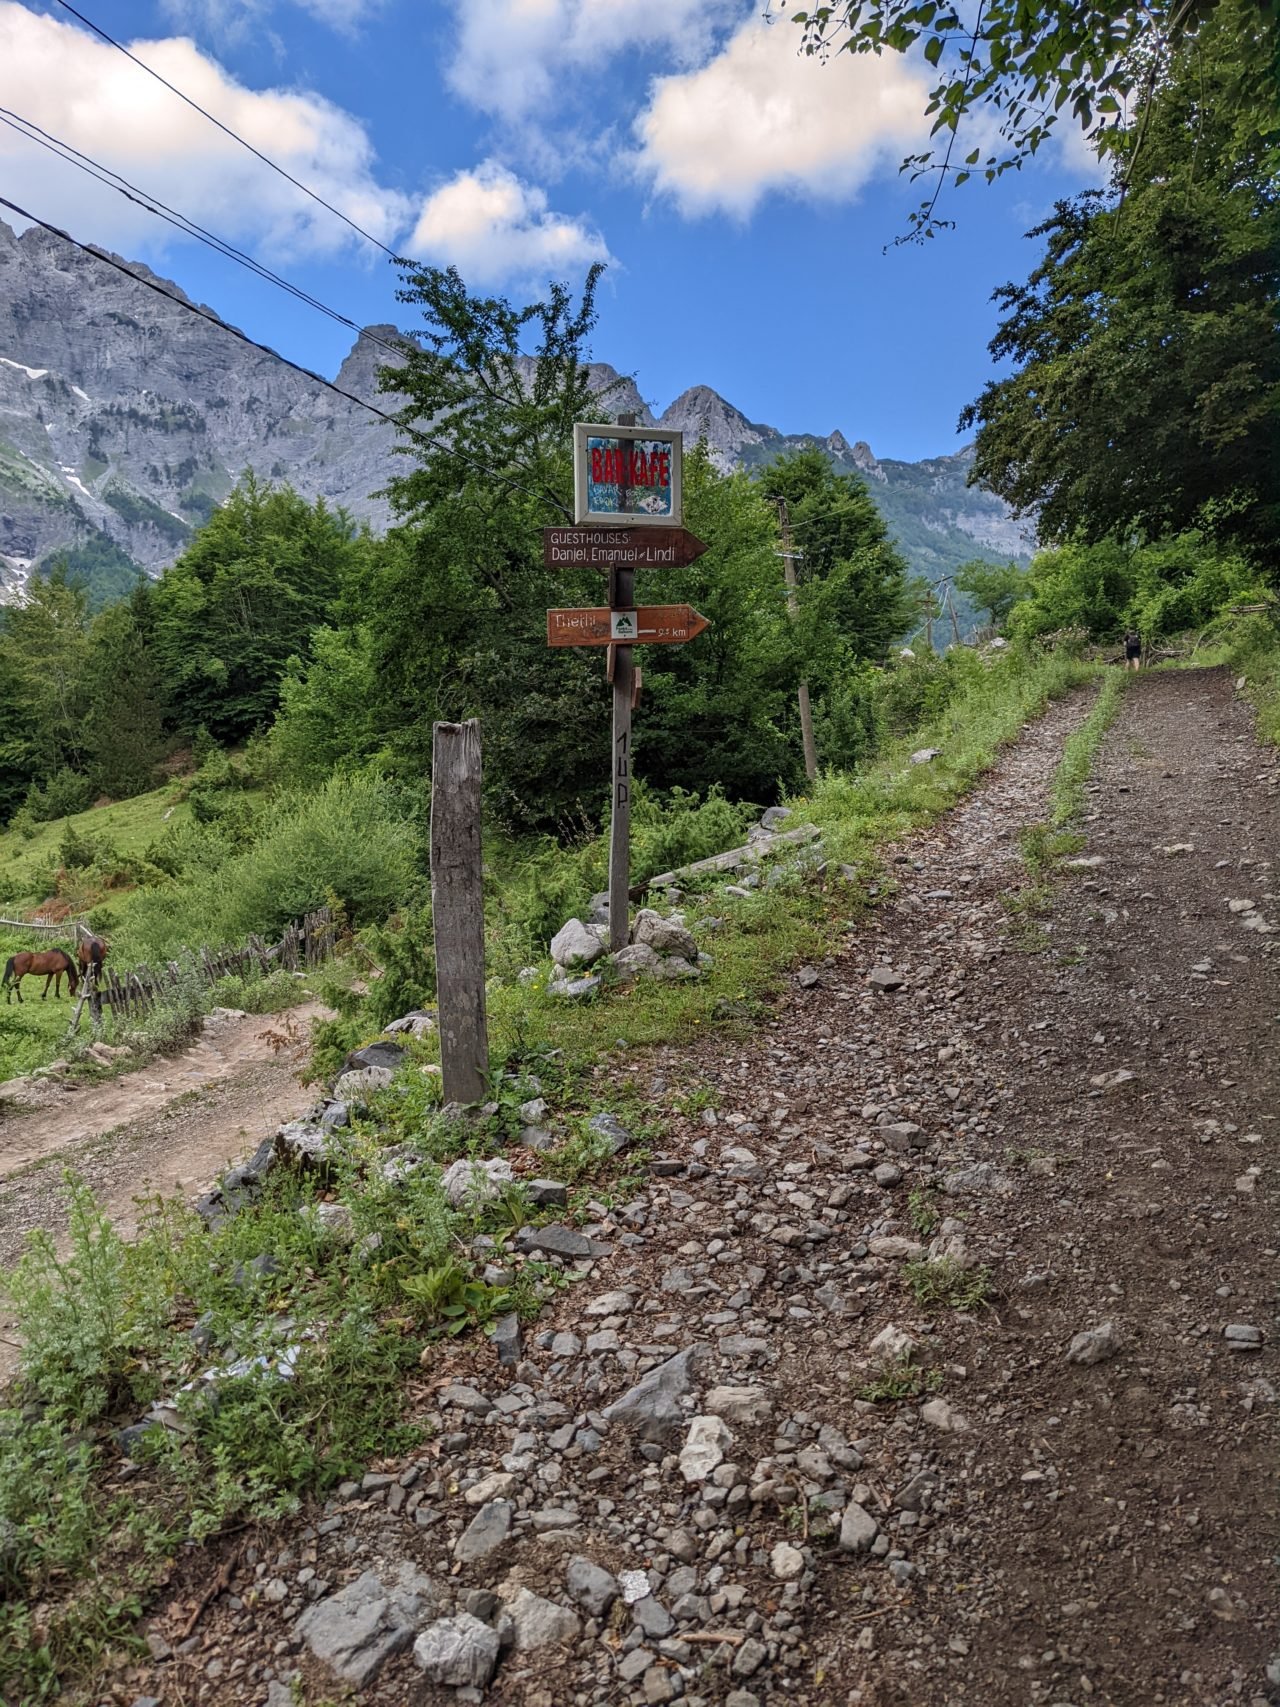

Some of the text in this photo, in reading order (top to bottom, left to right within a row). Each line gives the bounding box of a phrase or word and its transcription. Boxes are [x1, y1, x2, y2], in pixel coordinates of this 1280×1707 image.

[591, 447, 670, 488] BAR KAFE
[550, 532, 632, 545] GUESTHOUSES:
[591, 546, 638, 562] Emanuel
[646, 546, 675, 561] Lindi
[672, 627, 686, 637] km
